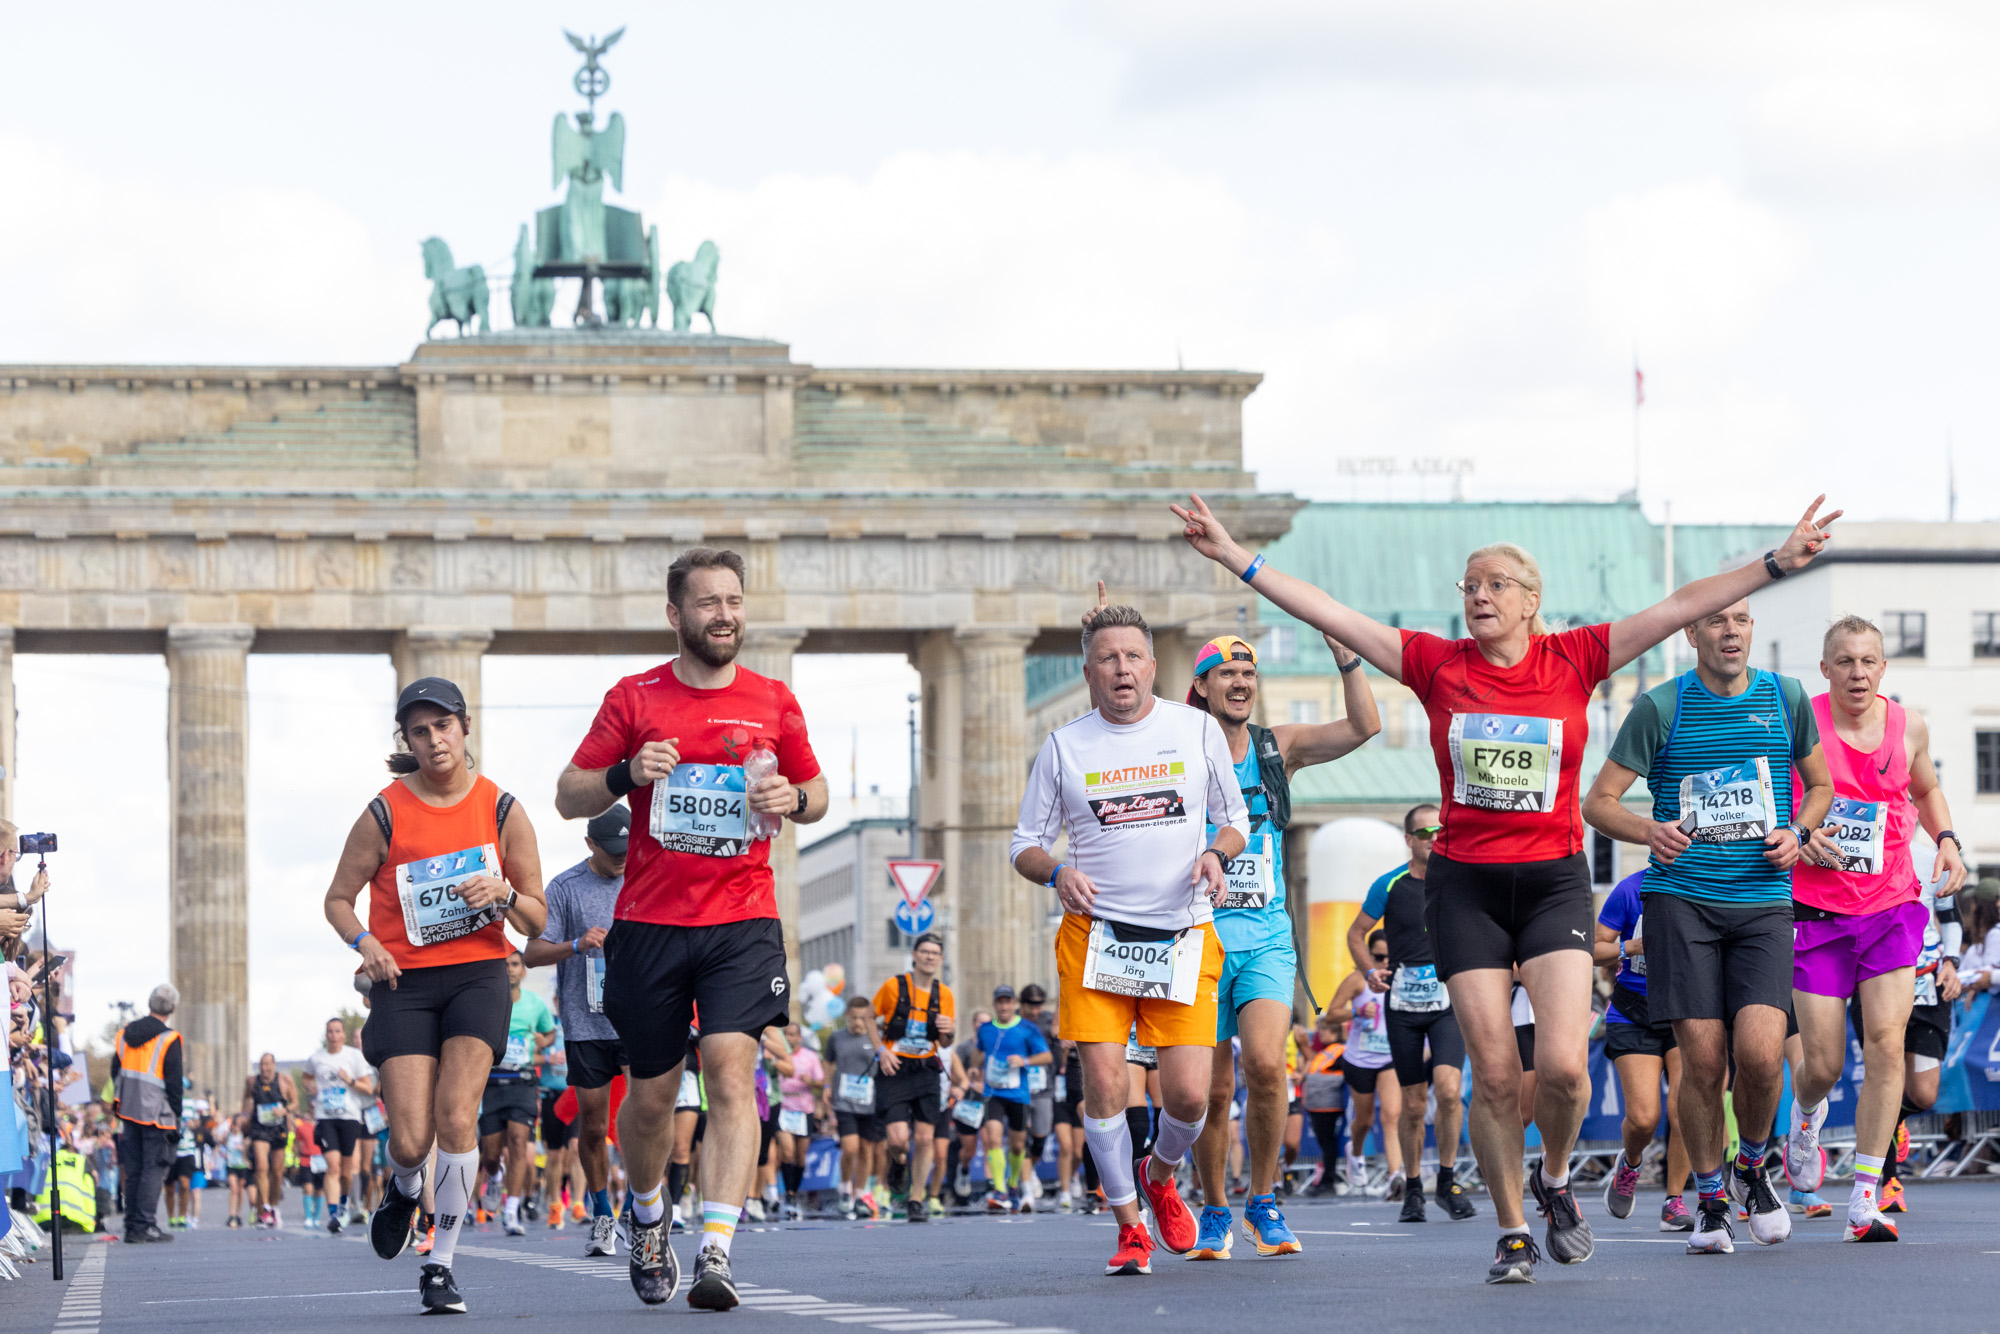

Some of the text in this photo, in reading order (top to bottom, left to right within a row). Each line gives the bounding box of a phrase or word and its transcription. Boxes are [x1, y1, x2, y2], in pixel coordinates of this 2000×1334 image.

[1474, 748, 1532, 769] F768
[1552, 749, 1559, 757] H
[1101, 763, 1168, 784] KATTNER
[1478, 772, 1529, 786] Michaela
[1091, 777, 1178, 793] www.kattner-stahlbau.de
[1467, 785, 1515, 800] IMPOSSIBLE
[1764, 781, 1770, 789] E
[669, 794, 741, 818] 58084
[1097, 795, 1171, 817] Jörg Zieger
[1466, 796, 1513, 810] IS NOTHING
[1700, 788, 1754, 811] 14218
[1711, 811, 1746, 822] Volker
[691, 820, 717, 832] Lars
[1100, 817, 1188, 833] www.fliesen-zieger.de
[1819, 822, 1871, 842] 082
[664, 834, 716, 847] IMPOSSIBLE
[1704, 832, 1741, 842] NOTHING
[672, 843, 713, 855] NOTHING
[492, 870, 499, 878] K
[1226, 859, 1256, 876] 273
[1229, 880, 1260, 889] Martin
[421, 917, 471, 936] IMPOSSIBLE
[432, 926, 471, 943] NOTHING
[1104, 944, 1169, 966] 40004
[1123, 964, 1145, 978] Jörg
[1096, 981, 1142, 996] IS NOTHING
[1097, 973, 1144, 989] IMPOSSIBLE
